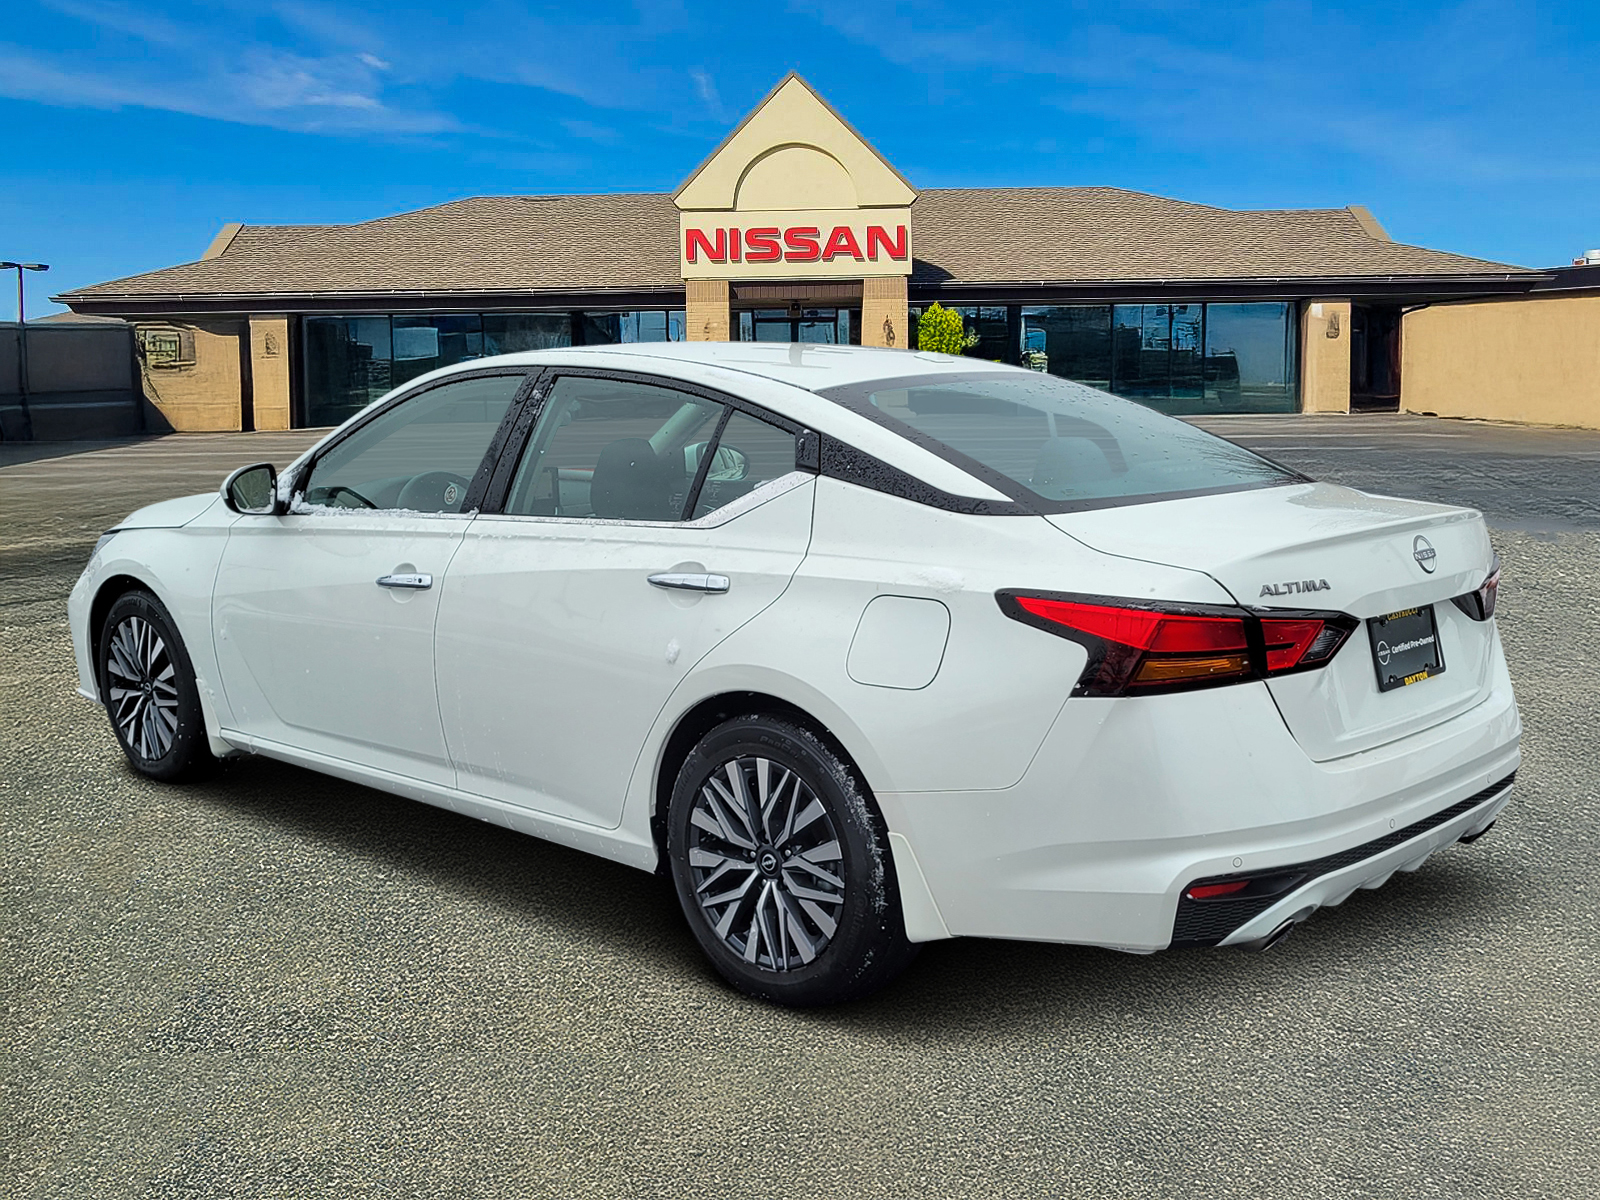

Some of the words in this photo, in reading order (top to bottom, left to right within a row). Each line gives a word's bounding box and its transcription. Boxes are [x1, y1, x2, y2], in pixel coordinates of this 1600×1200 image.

[685, 225, 907, 263] NISSAN
[1259, 578, 1331, 597] ALTIMA
[1391, 641, 1410, 654] Certified
[1410, 634, 1434, 648] Pre-Owned
[1404, 670, 1428, 686] DAYTON
